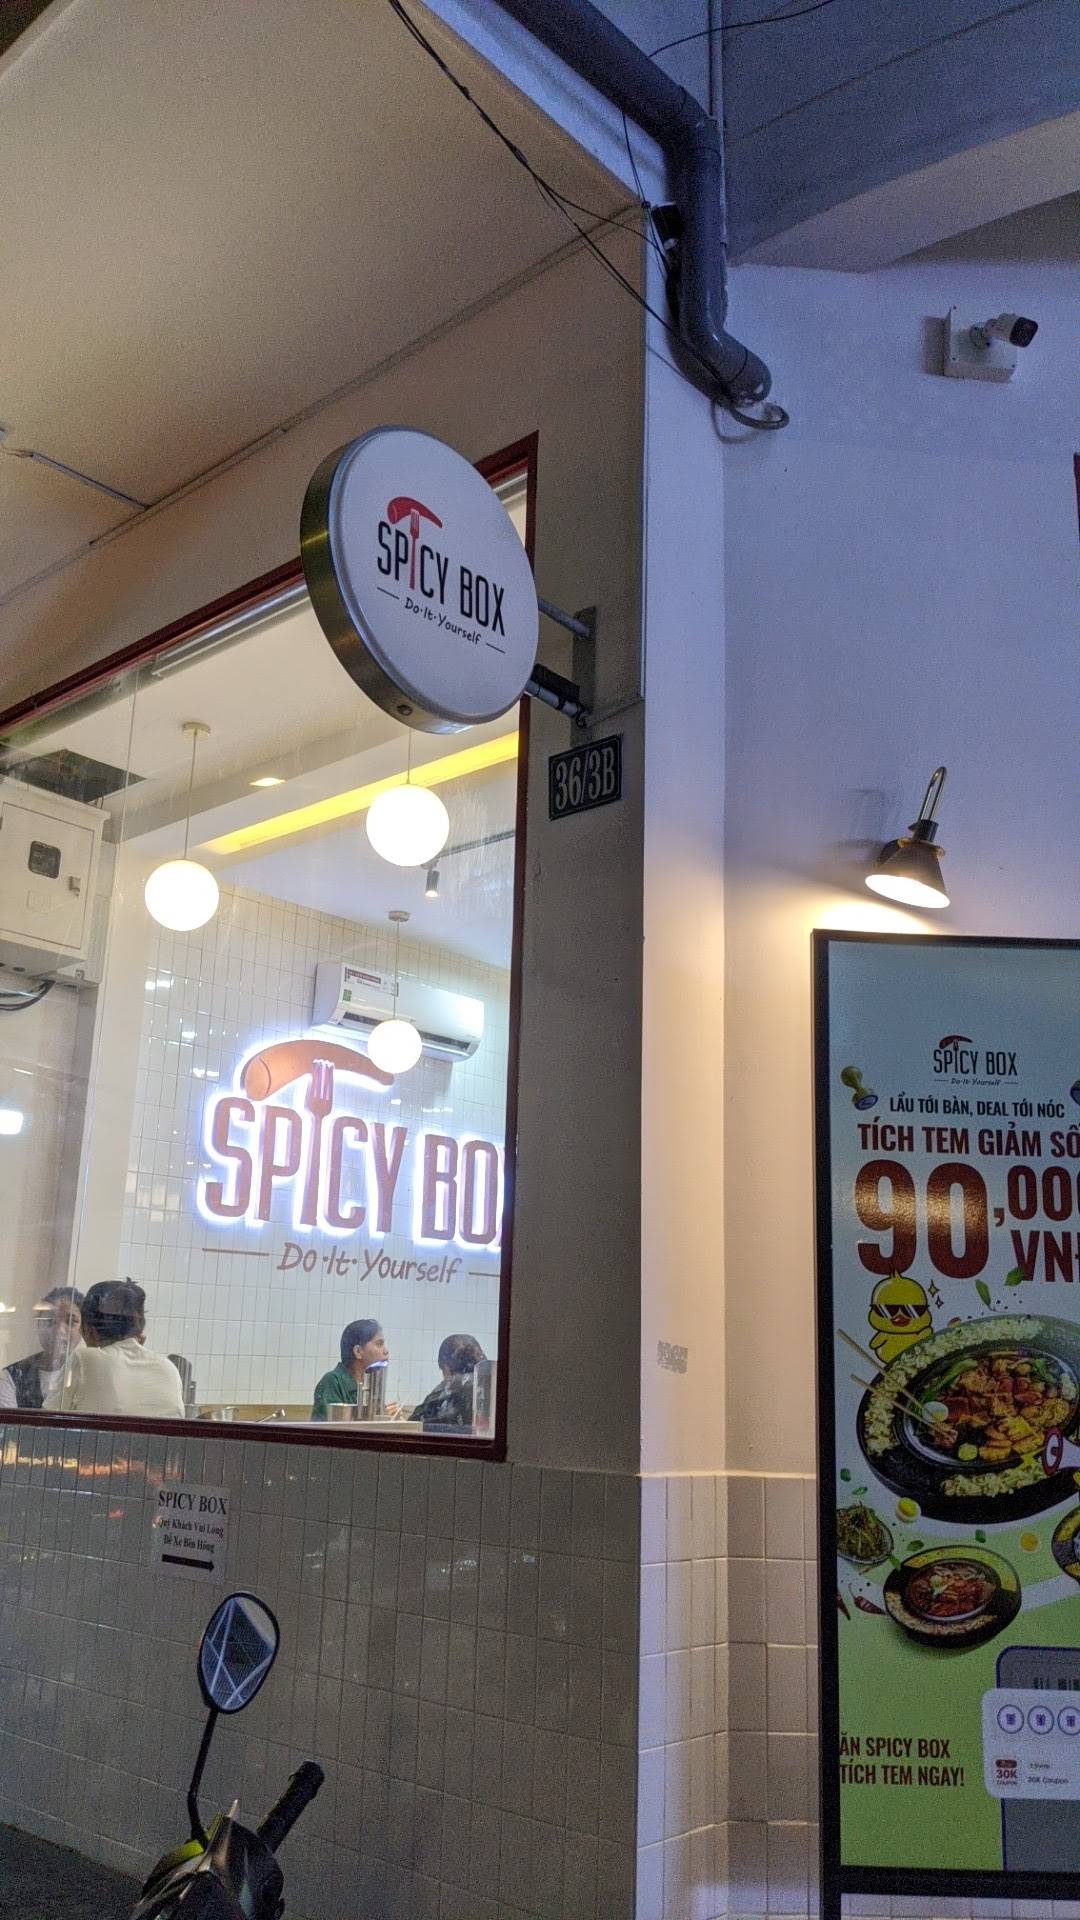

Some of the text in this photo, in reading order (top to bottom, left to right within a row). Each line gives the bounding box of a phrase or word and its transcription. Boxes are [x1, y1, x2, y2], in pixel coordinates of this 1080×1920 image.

[377, 512, 506, 637] SPICY BOX
[555, 747, 616, 810] 36/3B
[933, 1045, 1018, 1076] SPICY BOX
[889, 1091, 1065, 1119] LẨU TỚI BÀN, DEAL TỚI NÓC
[857, 1116, 914, 1153] TÍCH
[922, 1126, 970, 1155] TEM
[978, 1121, 1042, 1157] GIẢM
[204, 1068, 503, 1246] SPICY BO
[1011, 1229, 1080, 1283] VN
[158, 1490, 227, 1515] SPICY BOX
[839, 1732, 950, 1759] ĂN SPICY BOX
[840, 1758, 964, 1787] TÍCH TEM NGAY!
